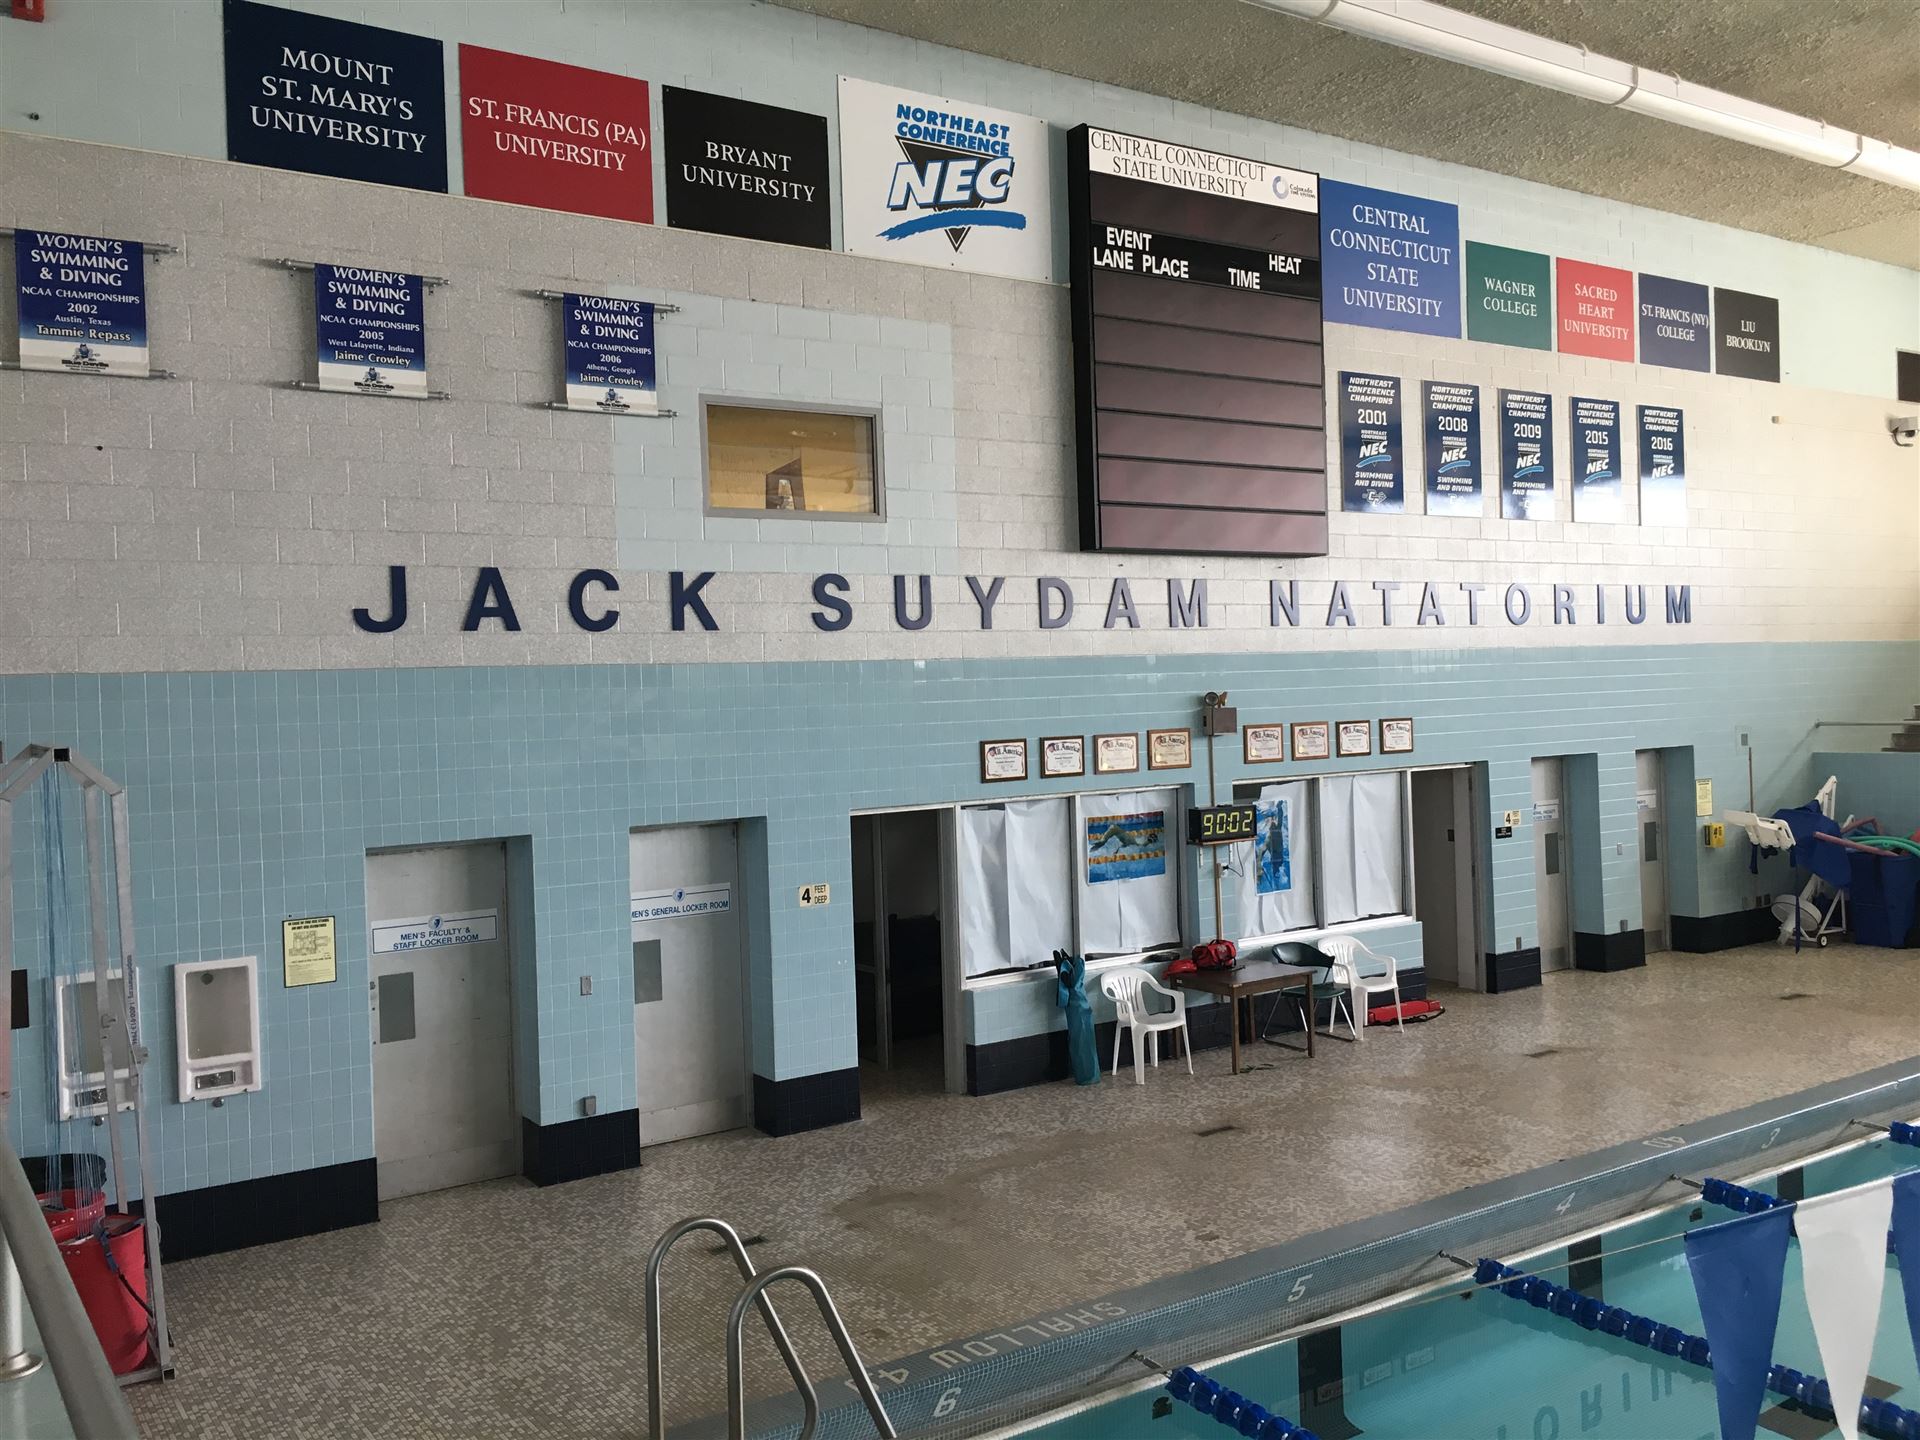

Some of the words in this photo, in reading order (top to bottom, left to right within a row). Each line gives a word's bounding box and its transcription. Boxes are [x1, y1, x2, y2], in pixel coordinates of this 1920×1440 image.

[281, 47, 393, 86] MOUNT
[261, 75, 301, 101] ST.
[309, 84, 414, 120] MARY'S
[250, 105, 427, 154] UNIVERSITY
[468, 96, 500, 120] ST.
[504, 102, 600, 138] FRANCIS
[605, 122, 646, 151] (PA)
[896, 103, 1010, 140] NORTHEAST
[897, 121, 1010, 157] CONFERENCE
[494, 131, 626, 171] UNIVERSITY
[705, 140, 791, 172] BRYANT
[1091, 130, 1162, 162] CENTRAL
[1165, 146, 1266, 182] CONNECTICUT
[682, 163, 816, 202] UNIVERSITY
[886, 156, 1015, 211] NEC
[1113, 156, 1157, 181] STATE
[1161, 165, 1247, 197] UNIVERSITY
[1352, 204, 1430, 235] CENTRAL
[36, 233, 123, 254] WOMEN'S
[1106, 227, 1152, 251] EVENT
[1269, 254, 1301, 276] HEAT
[1330, 228, 1451, 265] CONNECTICUT
[31, 249, 128, 271] SWIMMING
[1093, 247, 1133, 271] LANE
[1142, 254, 1189, 279] PLACE
[1228, 268, 1260, 290] TIME
[40, 267, 52, 280] &
[60, 268, 122, 286] DIVING
[333, 266, 406, 286] WOMEN'S
[1367, 262, 1419, 287] STATE
[21, 286, 52, 297] NCAA
[55, 289, 140, 304] CHAMPIONSHIPS
[328, 281, 410, 302] SWIMMING
[1484, 277, 1536, 298] WAGNER
[1574, 283, 1617, 302] SACRED
[67, 302, 98, 314] 2002
[335, 297, 346, 309] &
[353, 299, 405, 315] DIVING
[579, 296, 640, 313] WOMEN'S
[1343, 286, 1442, 317] UNIVERSITY
[1483, 296, 1537, 317] COLLEGE
[574, 309, 644, 327] SWIMMING
[1578, 302, 1614, 320] HEART
[1641, 303, 1654, 317] ST.
[1655, 305, 1691, 323] FRANCIS
[1691, 312, 1709, 328] (NY)
[54, 314, 85, 325] Austin,
[88, 317, 111, 326] Texas
[320, 314, 346, 324] NCAA
[349, 317, 420, 332] CHAMPIONSHIPS
[1741, 320, 1756, 333] LIU
[36, 324, 84, 338] Tammie
[89, 328, 131, 342] Repass
[359, 330, 384, 340] 2005
[580, 324, 590, 335] &
[595, 325, 639, 340] DIVING
[1564, 319, 1629, 340] UNIVERSITY
[1657, 324, 1695, 342] COLLEGE
[328, 338, 347, 347] West
[349, 341, 386, 352] Lafayette,
[388, 344, 415, 353] Indiana
[567, 340, 590, 349] NCAA
[592, 342, 651, 355] CHAMPIONSHIPS
[1726, 334, 1771, 353] BROOKLYN
[335, 350, 364, 361] Jaime
[368, 353, 411, 368] Crowley
[600, 354, 621, 364] 2006
[586, 364, 610, 372] Athens,
[611, 366, 636, 375] Georgia
[580, 373, 605, 383] Jaime
[608, 375, 644, 388] Crowley
[1349, 376, 1394, 388] NORTHEAST
[1348, 385, 1395, 397] CONFERENCE
[1430, 393, 1474, 405] CONFERENCE
[1432, 385, 1472, 396] NORTHEAST
[1508, 394, 1546, 404] NORTHEAST
[1350, 394, 1393, 405] CHAMPIONS
[1432, 402, 1472, 412] CHAMPIONS
[1506, 402, 1547, 412] CONFERENCE
[1578, 402, 1614, 411] NORTHEAST
[1358, 408, 1387, 426] 2001
[1508, 410, 1545, 420] CHAMPIONS
[1576, 410, 1615, 419] CONFERENCE
[1578, 417, 1613, 426] CHAMPIONS
[1644, 409, 1678, 418] NORTHEAST
[1644, 416, 1679, 426] CONFERENCE
[1438, 416, 1468, 432] 2008
[1514, 422, 1541, 438] 2009
[1645, 424, 1678, 432] CHAMPIONS
[1585, 430, 1608, 444] 2015
[1651, 436, 1673, 450] 2016
[1359, 441, 1388, 458] NEC
[1441, 446, 1467, 464] NEC
[1516, 453, 1541, 469] NEC
[1586, 458, 1610, 474] NEC
[1355, 472, 1393, 480] SWIMMING
[1437, 476, 1472, 484] SWIMMING
[1652, 463, 1674, 480] NEC
[1512, 481, 1546, 489] SWIMMING
[353, 565, 720, 633] JACK
[811, 573, 1209, 631] SUYDAM
[1269, 579, 1691, 626] NATATORIUM
[1203, 810, 1253, 836] 90:02
[1506, 813, 1511, 824] 4
[802, 888, 812, 904] 4
[815, 884, 826, 893] FEET
[651, 906, 681, 916] GENERAL
[682, 903, 708, 912] LOCKER
[710, 900, 728, 909] ROOM
[814, 895, 827, 904] DEEP
[393, 942, 416, 951] STAFF
[420, 937, 452, 947] LOCKER
[455, 934, 479, 942] ROOM
[400, 931, 426, 940] MEN'S
[428, 928, 462, 938] FACULTY
[1556, 1192, 1576, 1214] 4
[1287, 1274, 1314, 1303] 5
[928, 1301, 1127, 1369] SHALLOW
